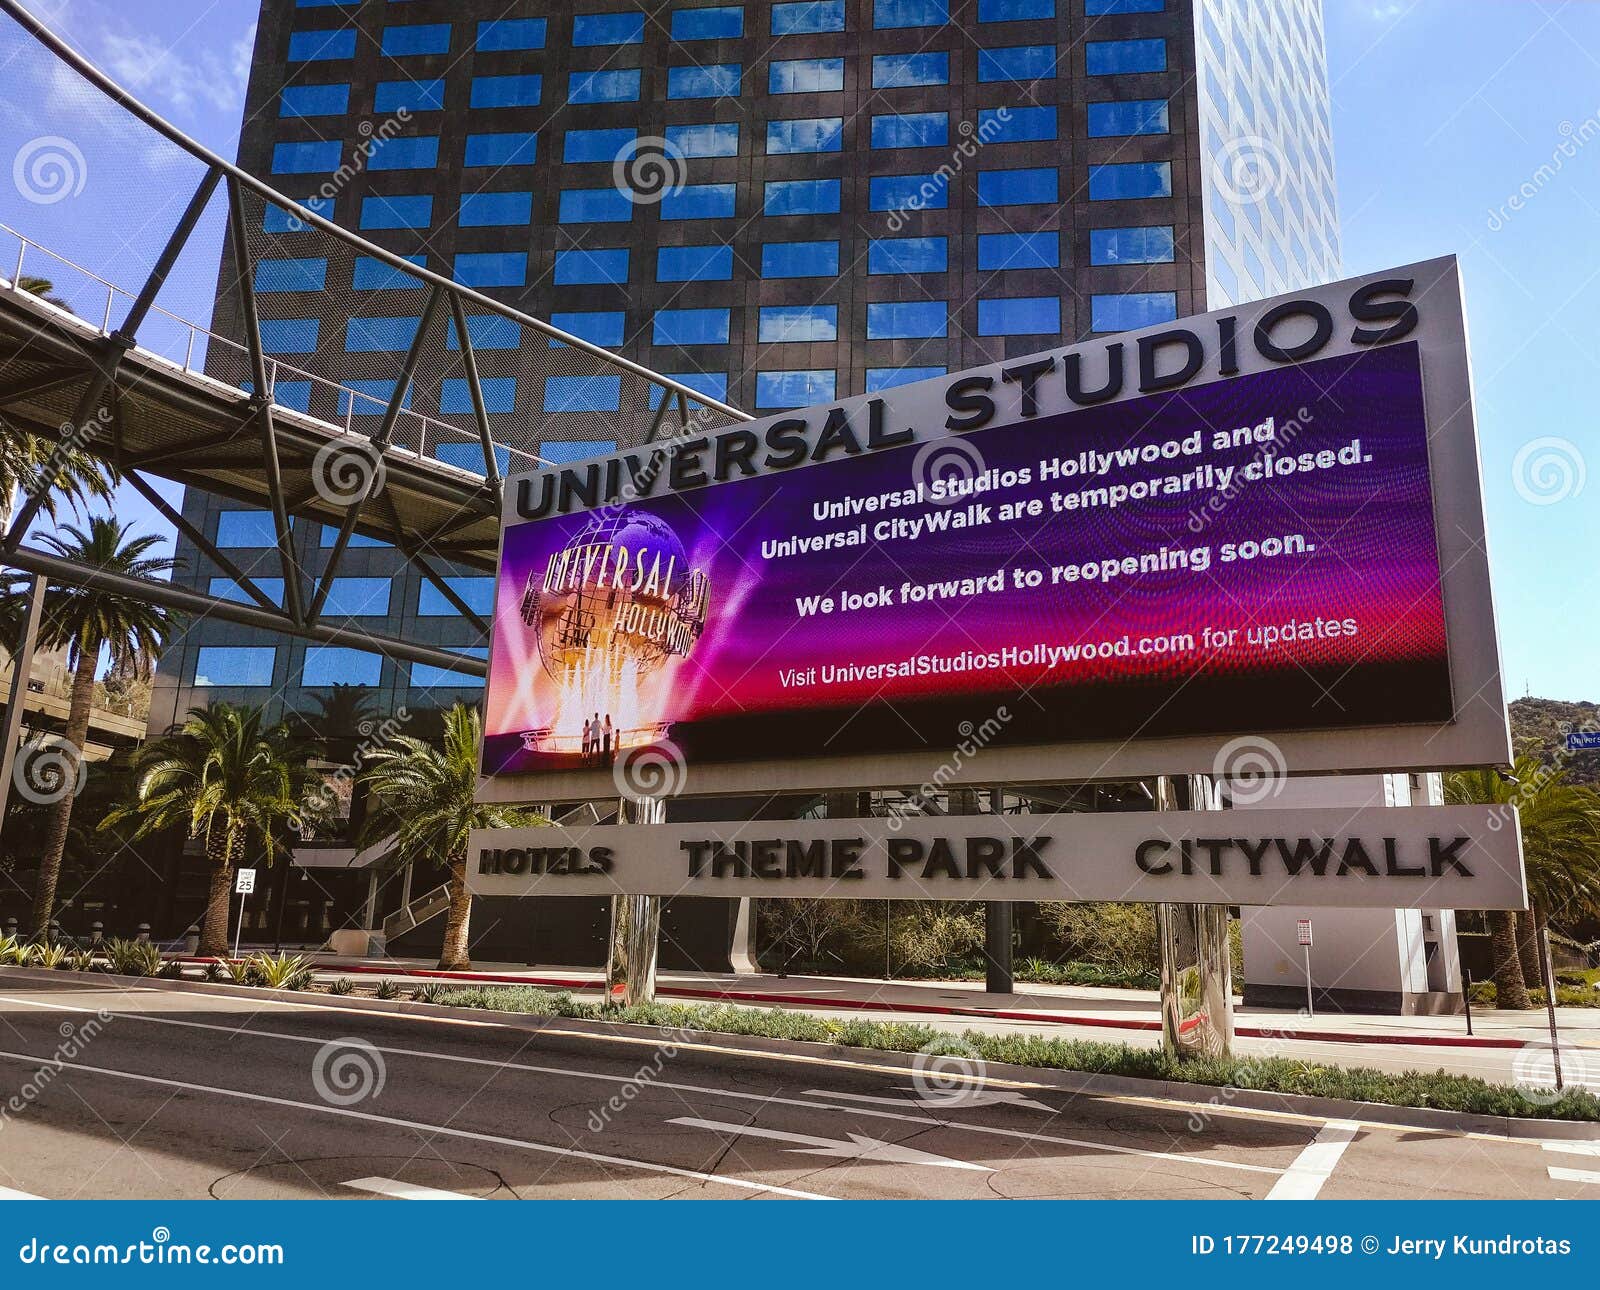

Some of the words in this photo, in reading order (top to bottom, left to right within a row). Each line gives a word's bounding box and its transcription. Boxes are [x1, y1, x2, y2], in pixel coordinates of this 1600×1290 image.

[516, 398, 914, 520] UNIVERSAL
[944, 278, 1419, 431] STUDIOS
[761, 524, 867, 559] Universal
[873, 504, 992, 540] CityWalk
[998, 499, 1043, 521] are
[1051, 464, 1235, 512] temporarily
[1243, 439, 1373, 481] closed.
[813, 483, 923, 521] Universal
[930, 465, 1032, 500] Studios
[1040, 431, 1202, 481] Hollywood
[1212, 416, 1275, 450] and
[542, 545, 675, 600] UNIVERSAL
[795, 597, 834, 617] We
[841, 585, 894, 612] look
[900, 569, 1005, 604] forward
[1012, 567, 1043, 589] to
[1051, 546, 1211, 585] reopening
[1219, 533, 1316, 563] soon.
[779, 667, 816, 688] Visit
[821, 633, 1195, 684] UniversalStudiosHollywood.com
[1201, 626, 1238, 649] for
[1247, 616, 1358, 649] updates
[239, 881, 252, 891] 25
[477, 846, 615, 875] HOTELS
[680, 837, 864, 879] THEME
[885, 837, 1053, 879] PARK
[1135, 837, 1475, 877] CITYWALK
